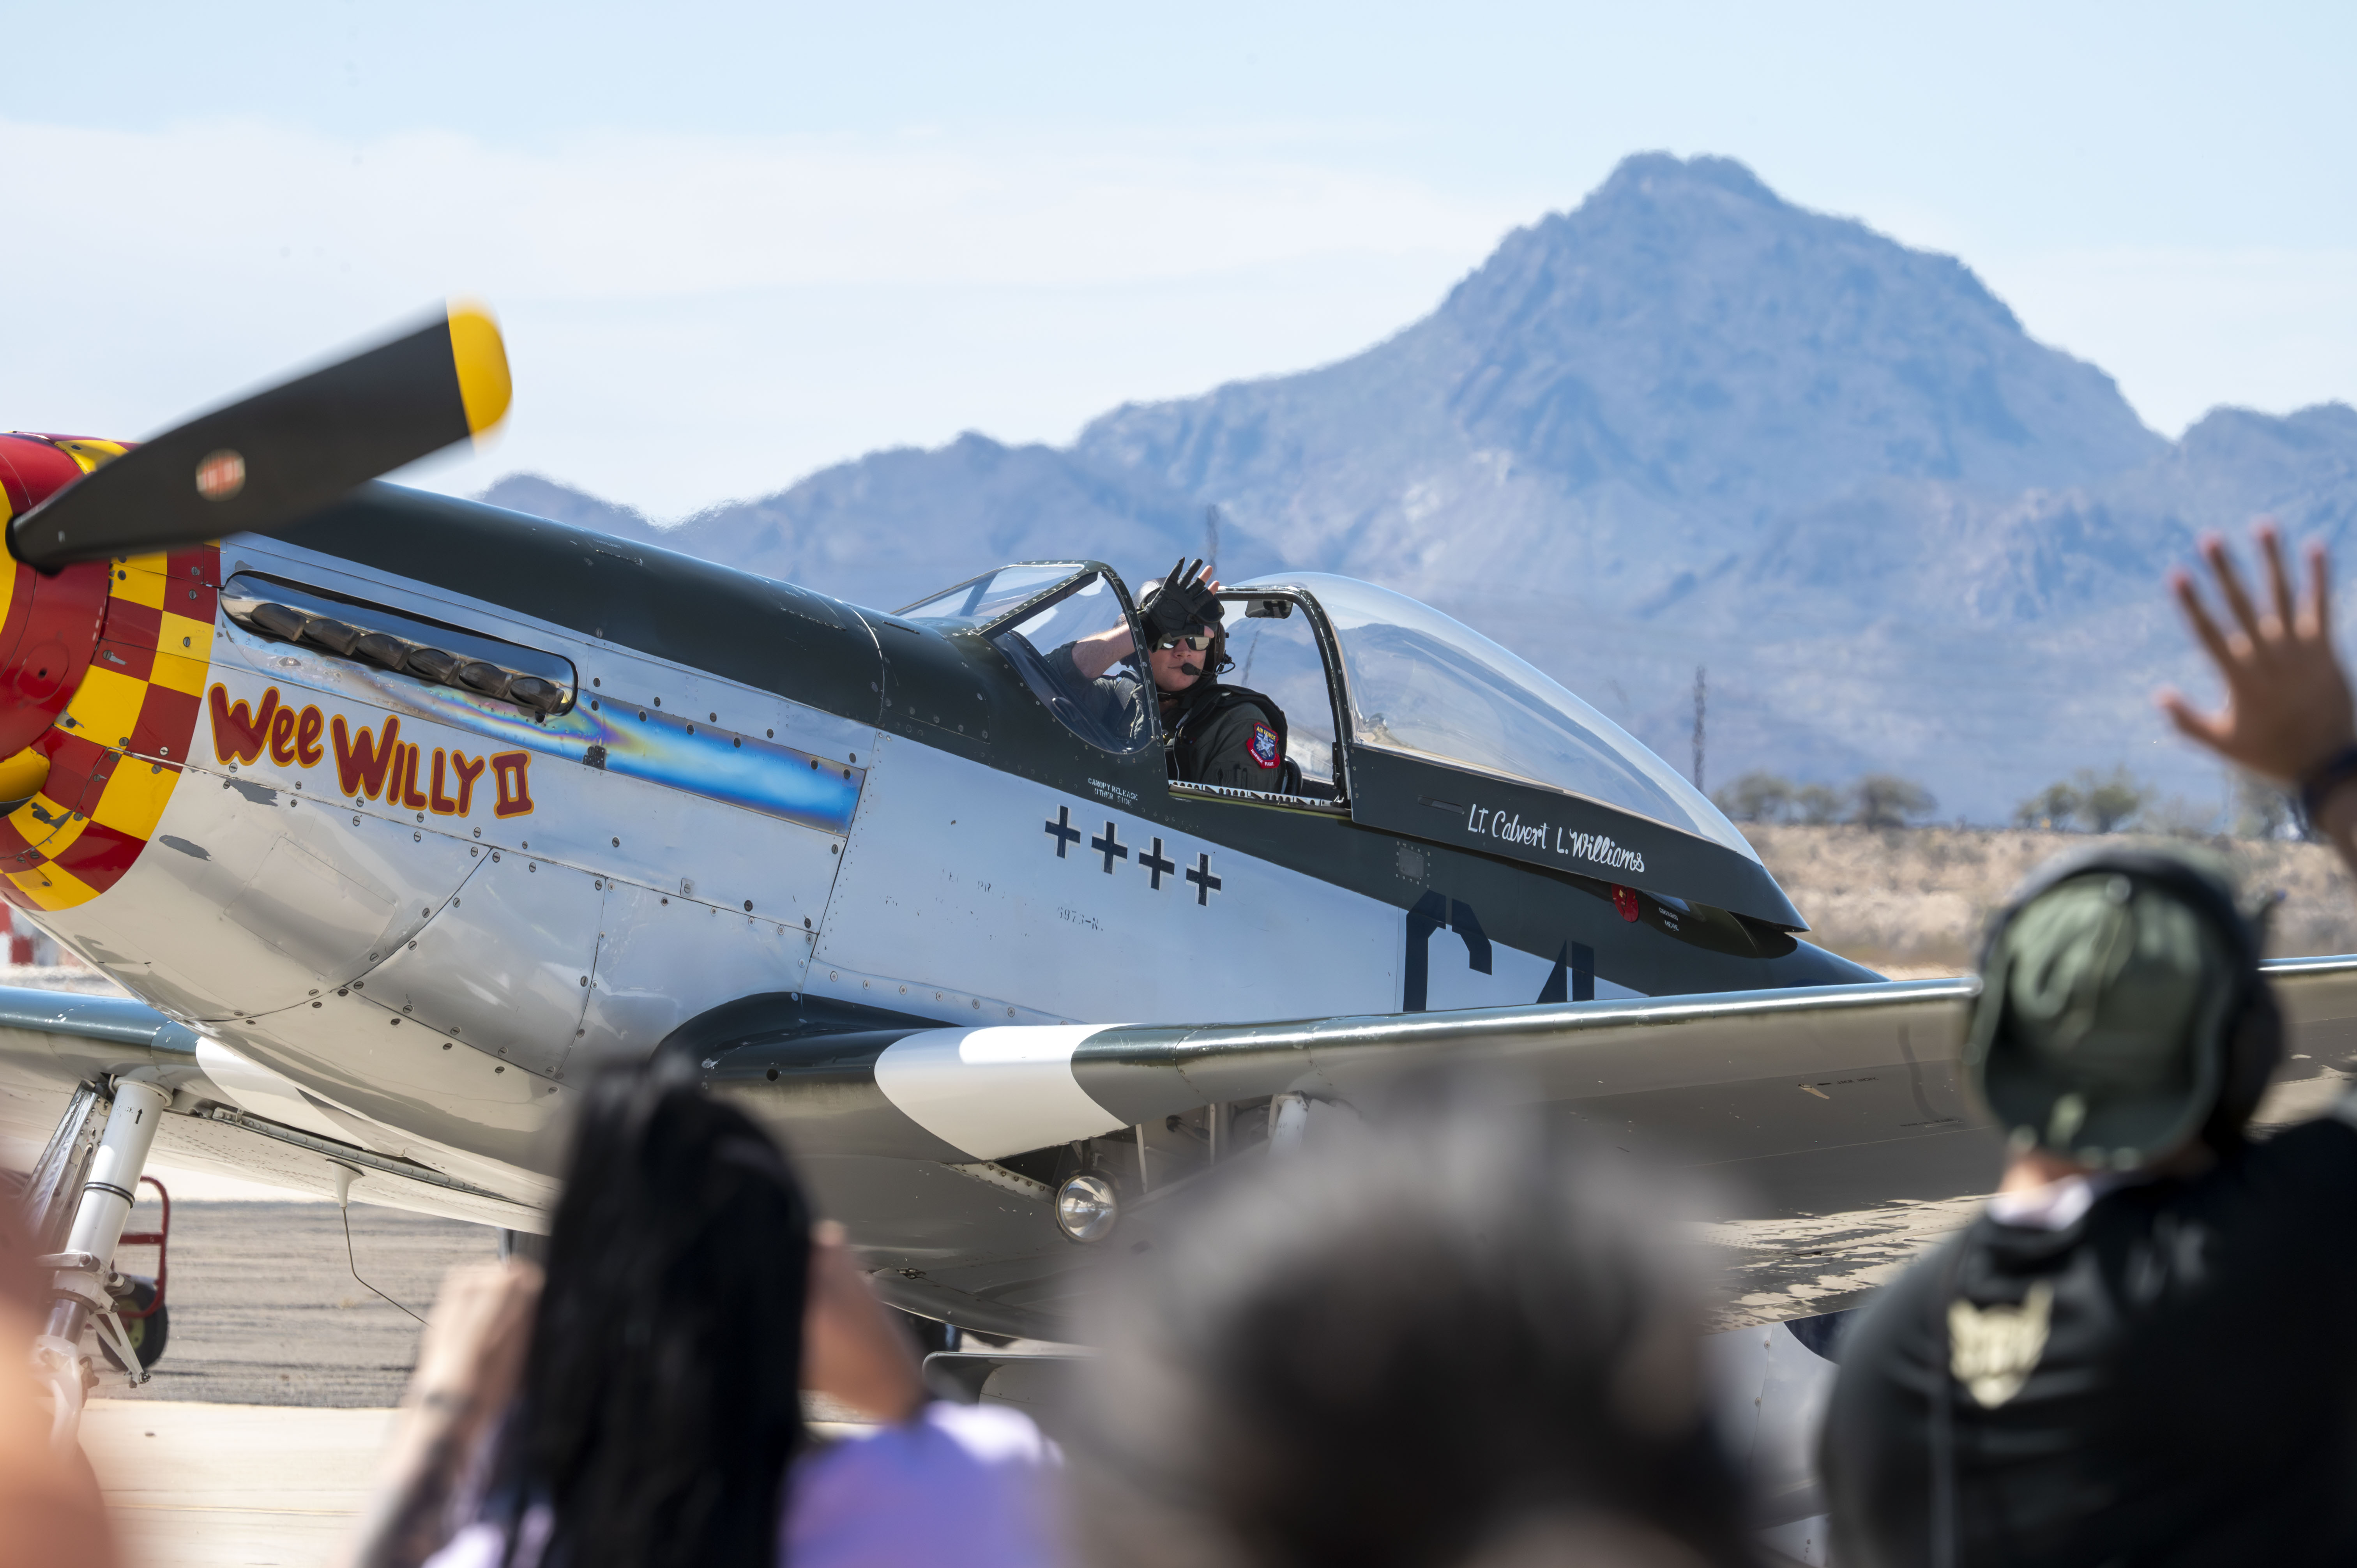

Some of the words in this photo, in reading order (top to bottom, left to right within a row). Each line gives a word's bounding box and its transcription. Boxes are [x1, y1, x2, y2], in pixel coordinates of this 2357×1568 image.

[207, 682, 324, 769] Wee
[1264, 729, 1276, 741] FORCE
[1251, 749, 1263, 764] HERITAGE
[1088, 778, 1110, 791] CANOPY
[1111, 785, 1138, 801] RELEASE
[1094, 788, 1113, 800] OTHER
[1492, 810, 1550, 849] Calvert
[1569, 828, 1645, 872] Williams
[1659, 907, 1679, 921] GROUND
